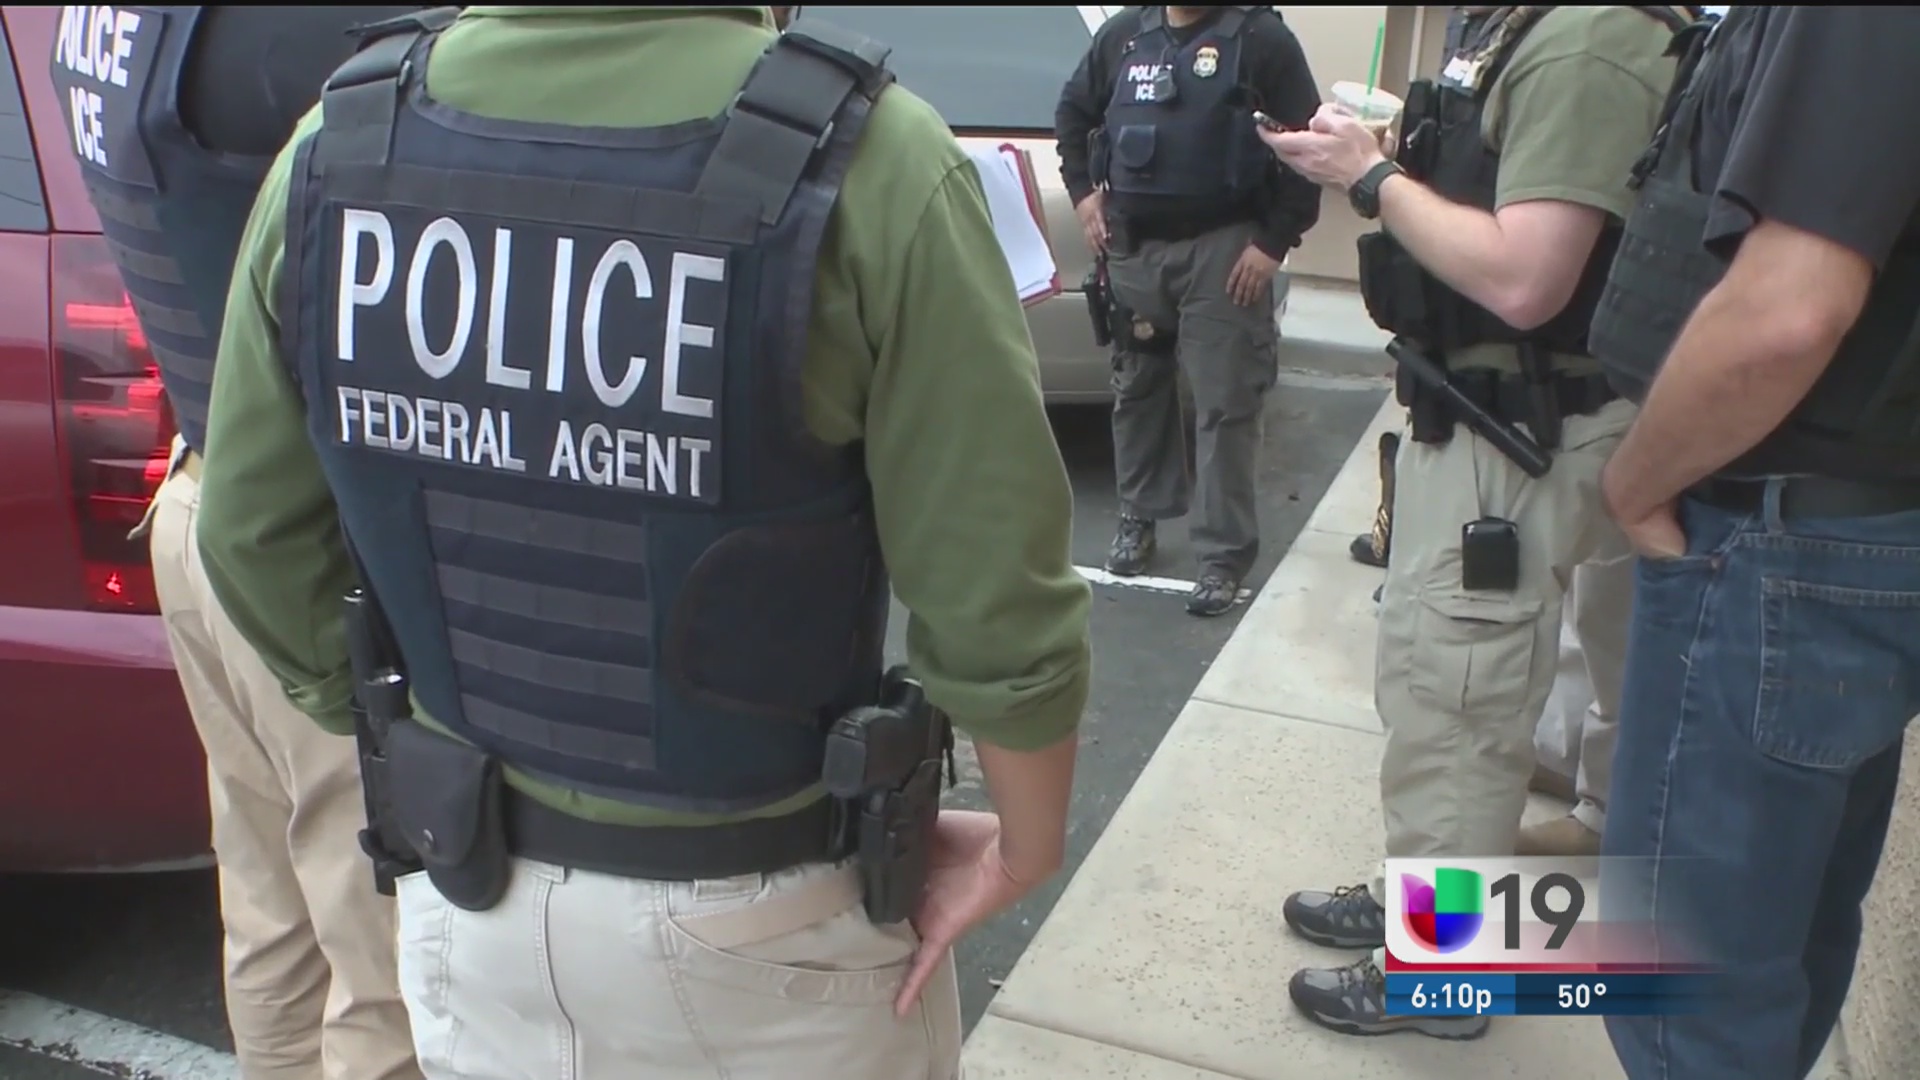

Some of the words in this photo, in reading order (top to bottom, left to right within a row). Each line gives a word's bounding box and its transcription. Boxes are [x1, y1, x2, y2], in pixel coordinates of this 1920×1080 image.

[1128, 64, 1173, 82] POLI
[1135, 83, 1156, 101] ICE
[70, 86, 107, 167] ICE
[338, 208, 725, 419] POLICE
[337, 386, 527, 472] FEDERAL
[548, 420, 712, 498] AGENT
